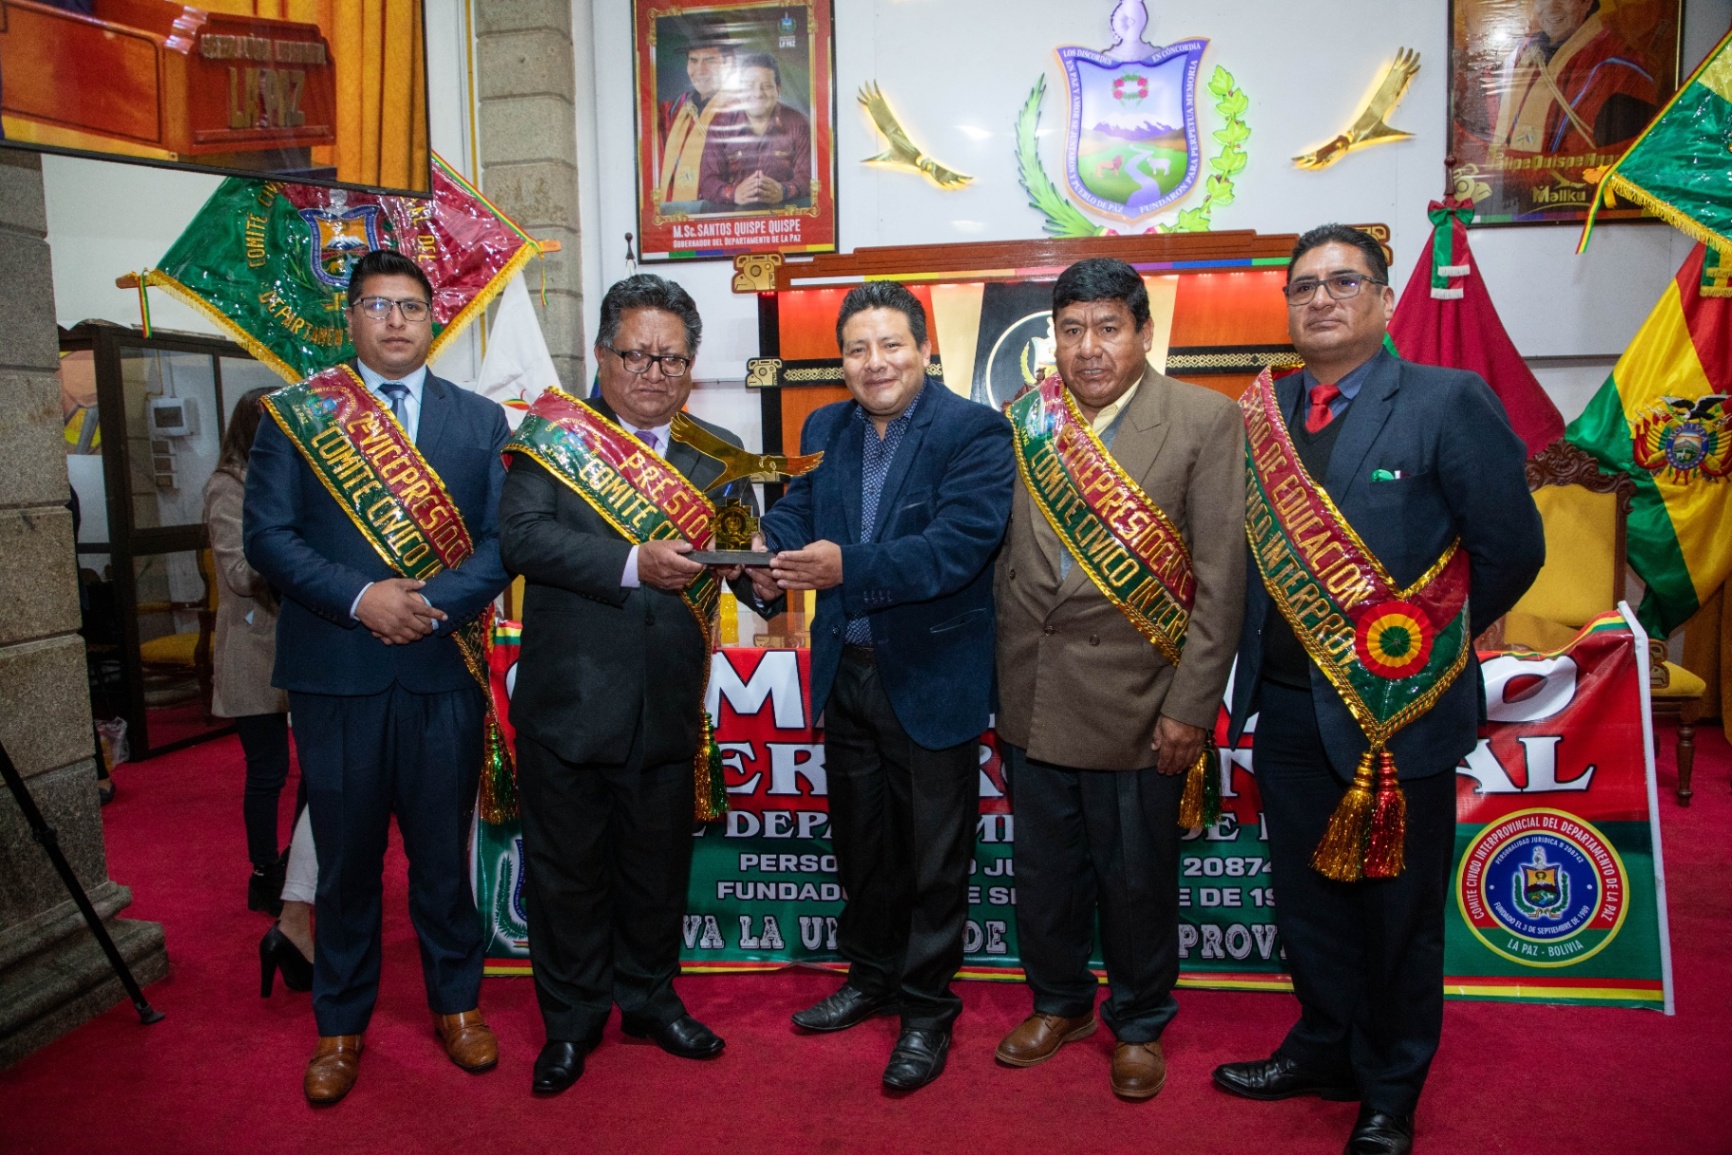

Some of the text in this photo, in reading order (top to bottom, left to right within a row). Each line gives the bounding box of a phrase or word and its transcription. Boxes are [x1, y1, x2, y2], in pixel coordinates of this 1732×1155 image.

[1063, 48, 1076, 58] LOS
[1152, 52, 1162, 62] EN
[1162, 42, 1201, 57] CONCORDIA
[1070, 72, 1079, 88] PAZ
[1140, 60, 1199, 214] FUNDARON PARA PERPETUA MEMORIA
[1071, 180, 1097, 204] PUEBLO
[1096, 200, 1106, 208] DE
[1532, 186, 1587, 203] Mallku
[1108, 204, 1124, 214] PAZ
[246, 212, 268, 269] COMITE
[698, 222, 732, 237] SANTOS
[734, 220, 766, 236] QUISPE
[768, 218, 800, 234] QUISPE
[311, 426, 382, 504] COMITE
[366, 496, 431, 567] CIVICO
[579, 459, 659, 528] COMITE
[1031, 444, 1086, 526] COMITE
[1074, 513, 1140, 588] CIVICO
[1256, 442, 1288, 485] DE
[1272, 474, 1376, 612] EDUCACION
[1495, 838, 1530, 865] PERSONALIDAD
[1531, 836, 1558, 846] JURIDICA
[1466, 816, 1618, 922] COMITE CIVICO INTERPROVINCIAL DEL DEPARTAMENTO DE LA PAZ
[1200, 888, 1242, 906] DE
[738, 915, 784, 949] LA
[1494, 902, 1516, 924] FUNDADO
[1528, 926, 1536, 934] DE
[1537, 921, 1572, 934] SEPTIEMBRE
[1570, 916, 1580, 926] DE
[1507, 938, 1518, 950] LA
[1521, 943, 1538, 956] PAZ
[1548, 940, 1584, 957] BOLIVIA
